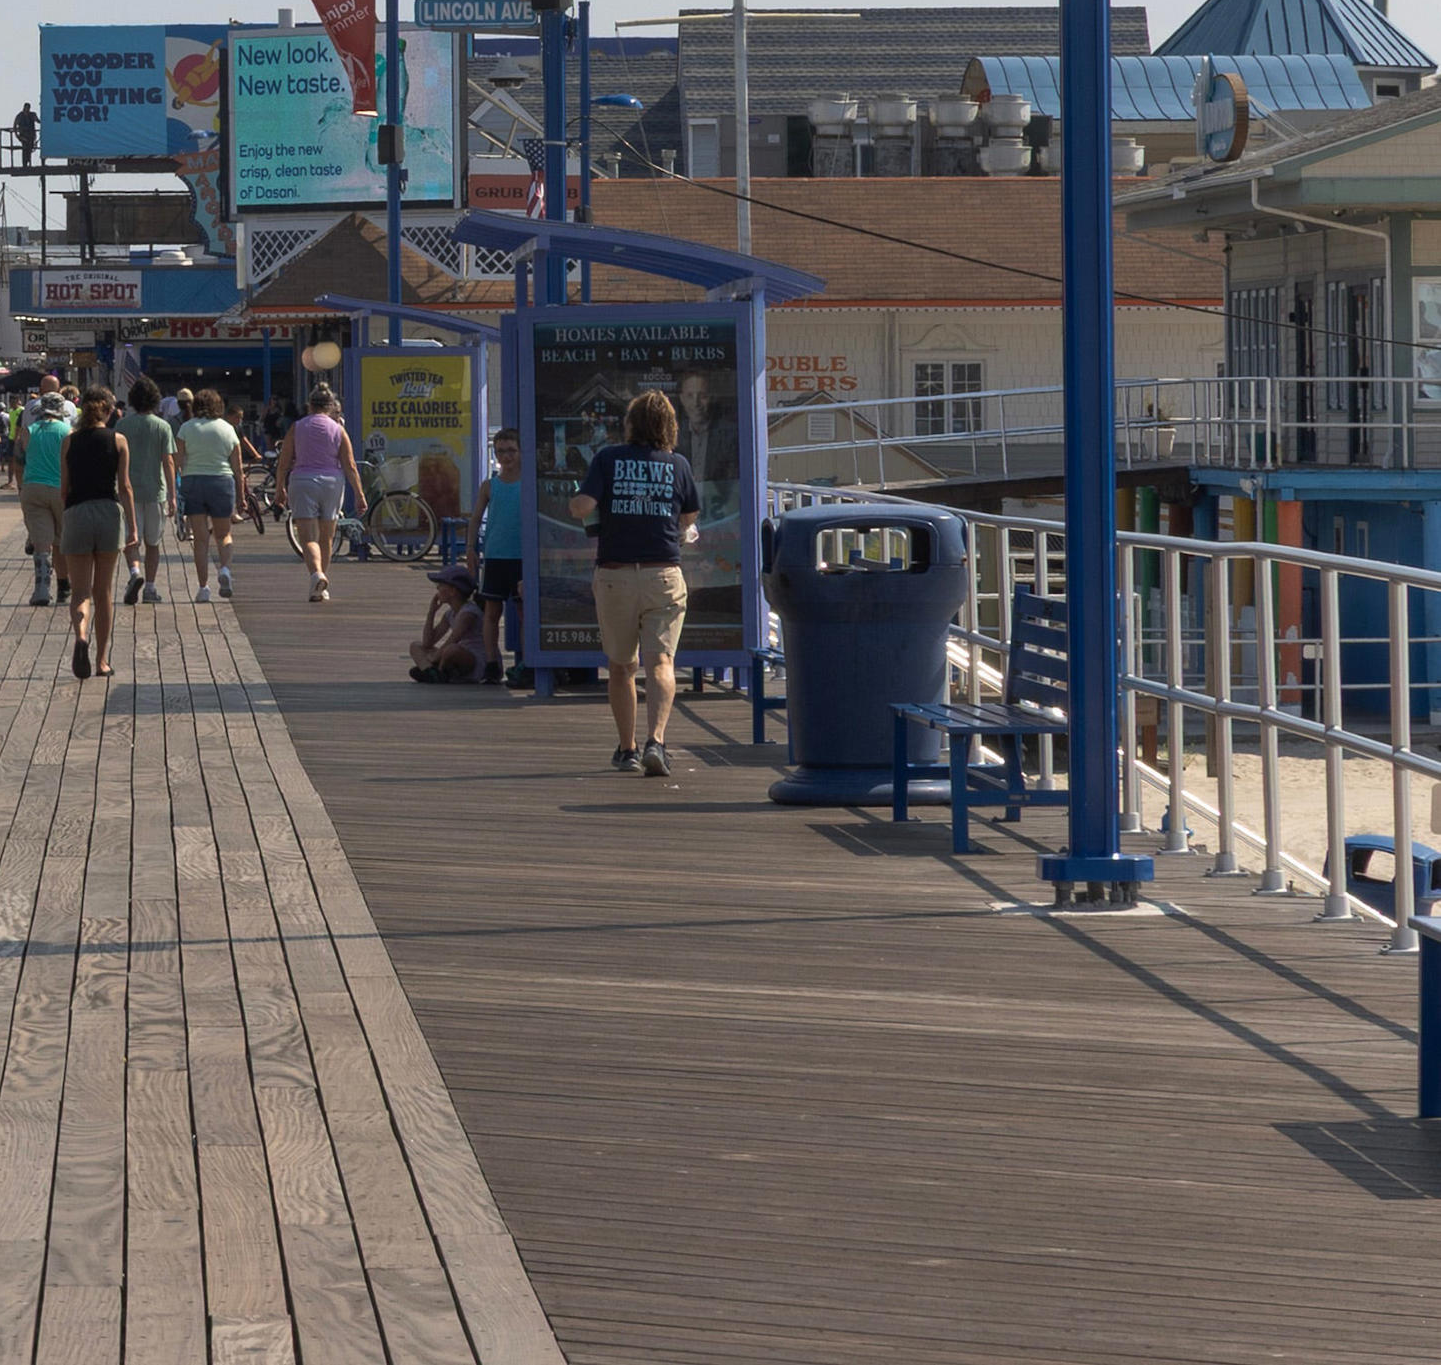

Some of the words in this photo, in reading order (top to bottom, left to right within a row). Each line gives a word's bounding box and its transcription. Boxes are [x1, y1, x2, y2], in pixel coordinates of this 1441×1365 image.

[330, 5, 369, 35] mmer
[423, 2, 496, 21] LINCOLN
[501, 2, 534, 21] AVE
[51, 52, 155, 70] WOODER
[238, 45, 282, 66] New
[287, 41, 333, 65] look.
[53, 70, 103, 86] YOU
[238, 75, 283, 96] New
[287, 72, 346, 94] taste.
[52, 87, 163, 105] WAITING
[53, 106, 109, 122] FOR!
[239, 144, 272, 160] Enjoy
[275, 143, 295, 156] the
[298, 144, 323, 156] new
[239, 165, 271, 180] crisp,
[275, 164, 307, 177] clean
[310, 162, 343, 176] taste
[239, 186, 253, 200] of
[255, 185, 301, 199] Dasani.
[475, 188, 524, 198] GRUB
[83, 272, 119, 282] ORIGINAL
[46, 284, 83, 300] HOT
[90, 284, 138, 300] SPOT
[122, 319, 165, 340] ORIGINAL
[170, 319, 217, 339] HOT
[555, 327, 616, 343] HOMES
[620, 325, 710, 341] AVAILABLE
[541, 349, 597, 363] BEACH
[620, 348, 650, 362] BAY
[671, 347, 726, 361] BURBS
[766, 355, 848, 372] OUBLE
[389, 372, 426, 386] TWISTED
[428, 373, 444, 386] TEA
[371, 401, 397, 415] LESS
[400, 401, 462, 415] CALORIES.
[371, 416, 395, 428] JUST
[398, 416, 411, 428] AS
[414, 416, 463, 428] TWISTED.
[370, 437, 385, 448] 110
[613, 459, 675, 485] BREWS
[611, 499, 643, 514] OCEAN
[643, 501, 672, 517] VIEWS
